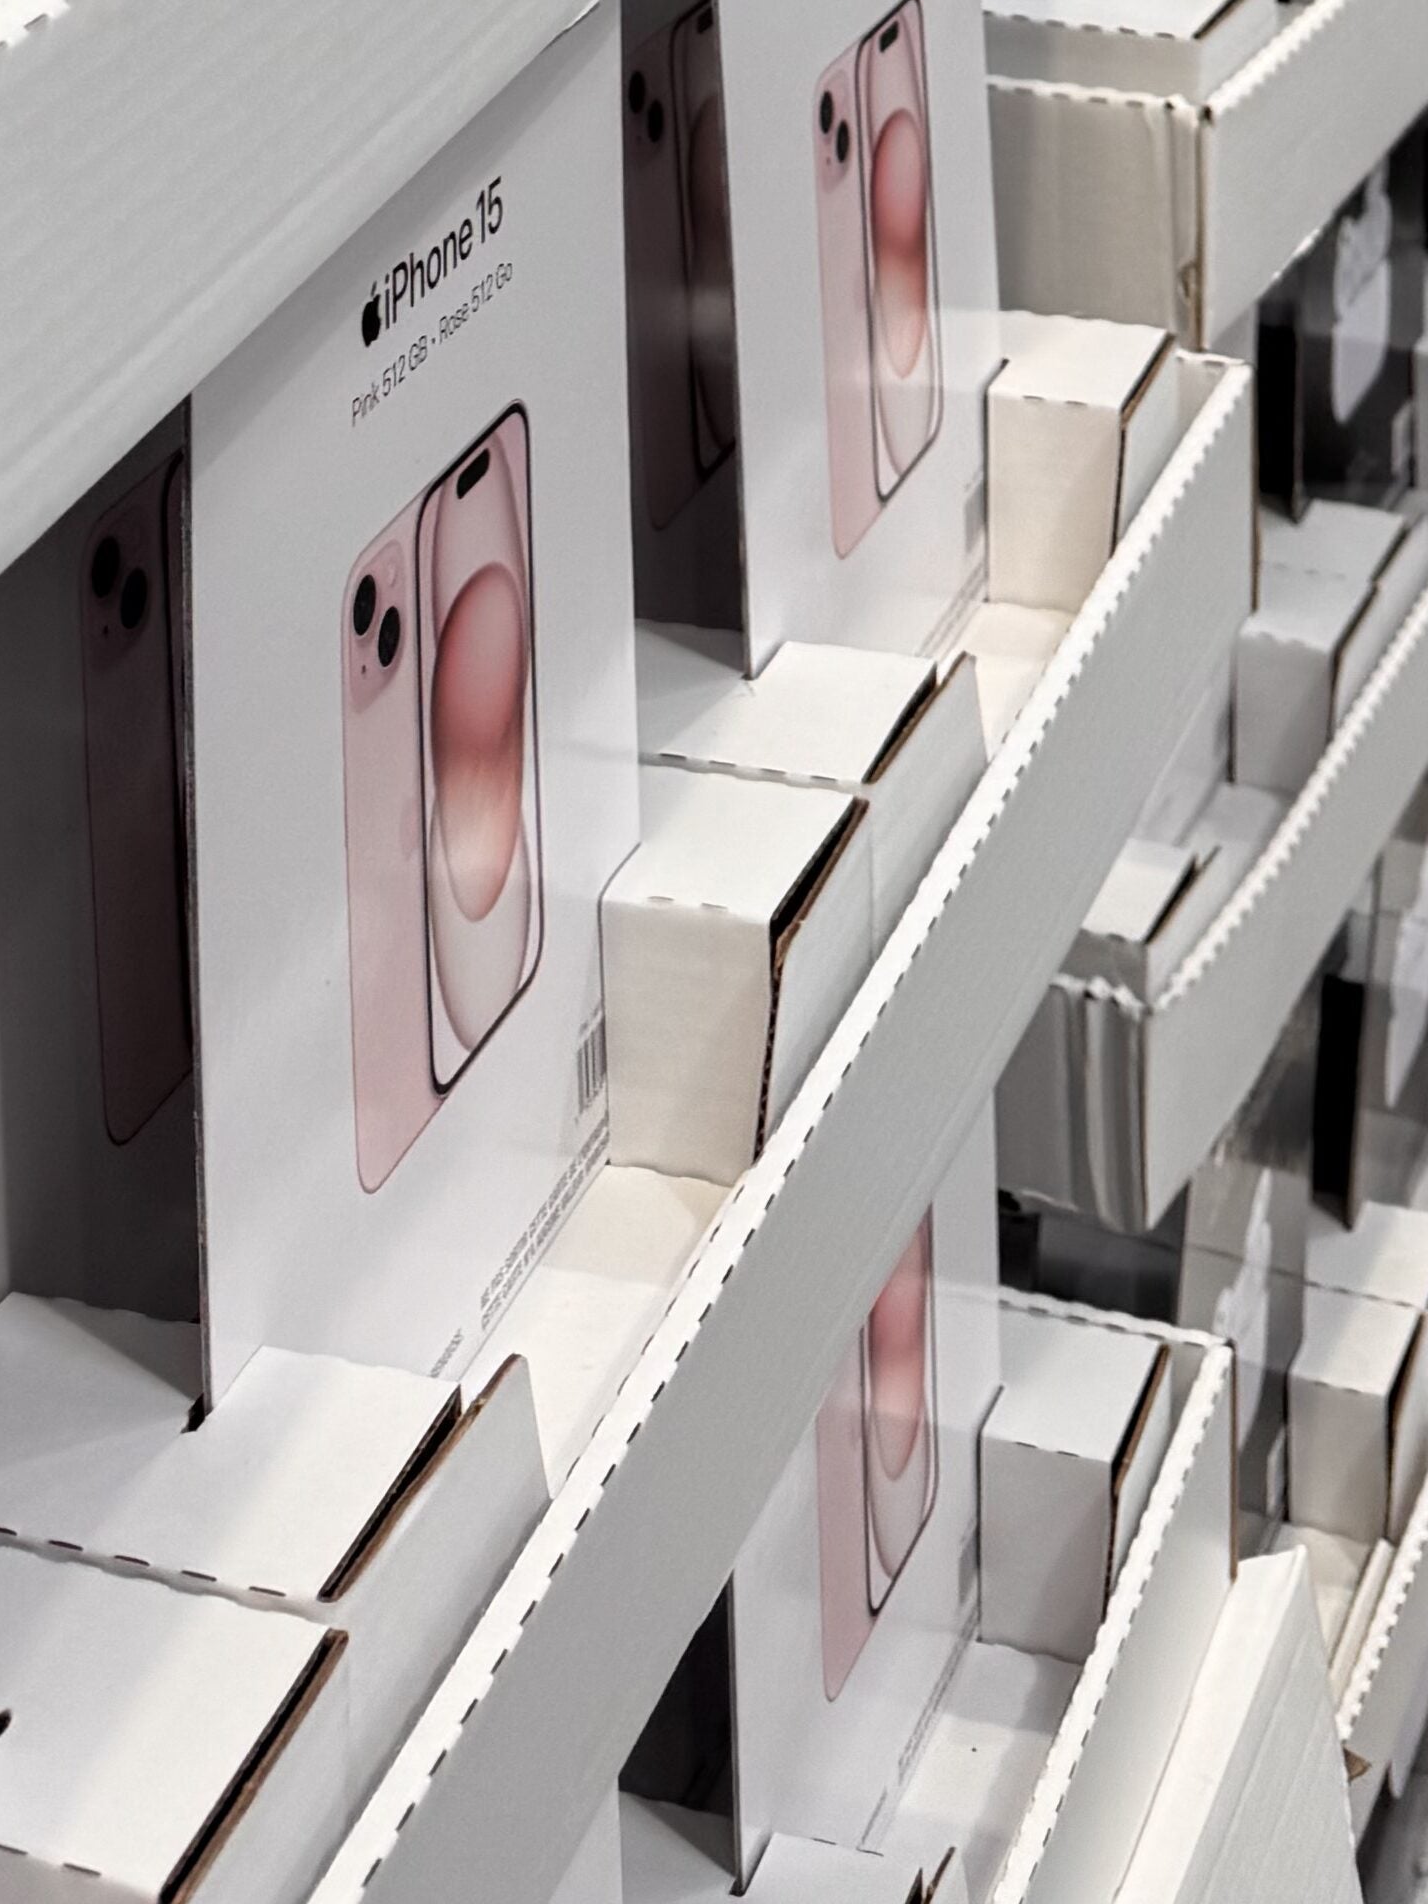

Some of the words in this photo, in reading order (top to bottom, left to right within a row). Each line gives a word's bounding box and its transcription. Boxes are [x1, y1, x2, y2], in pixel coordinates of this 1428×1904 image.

[384, 216, 473, 331] iPhone
[476, 176, 504, 244] 15
[352, 384, 379, 428] Pink
[382, 354, 406, 398] 512
[408, 335, 428, 372] GB
[438, 303, 469, 344] Rose
[471, 274, 494, 313] 512
[495, 262, 513, 291] Go
